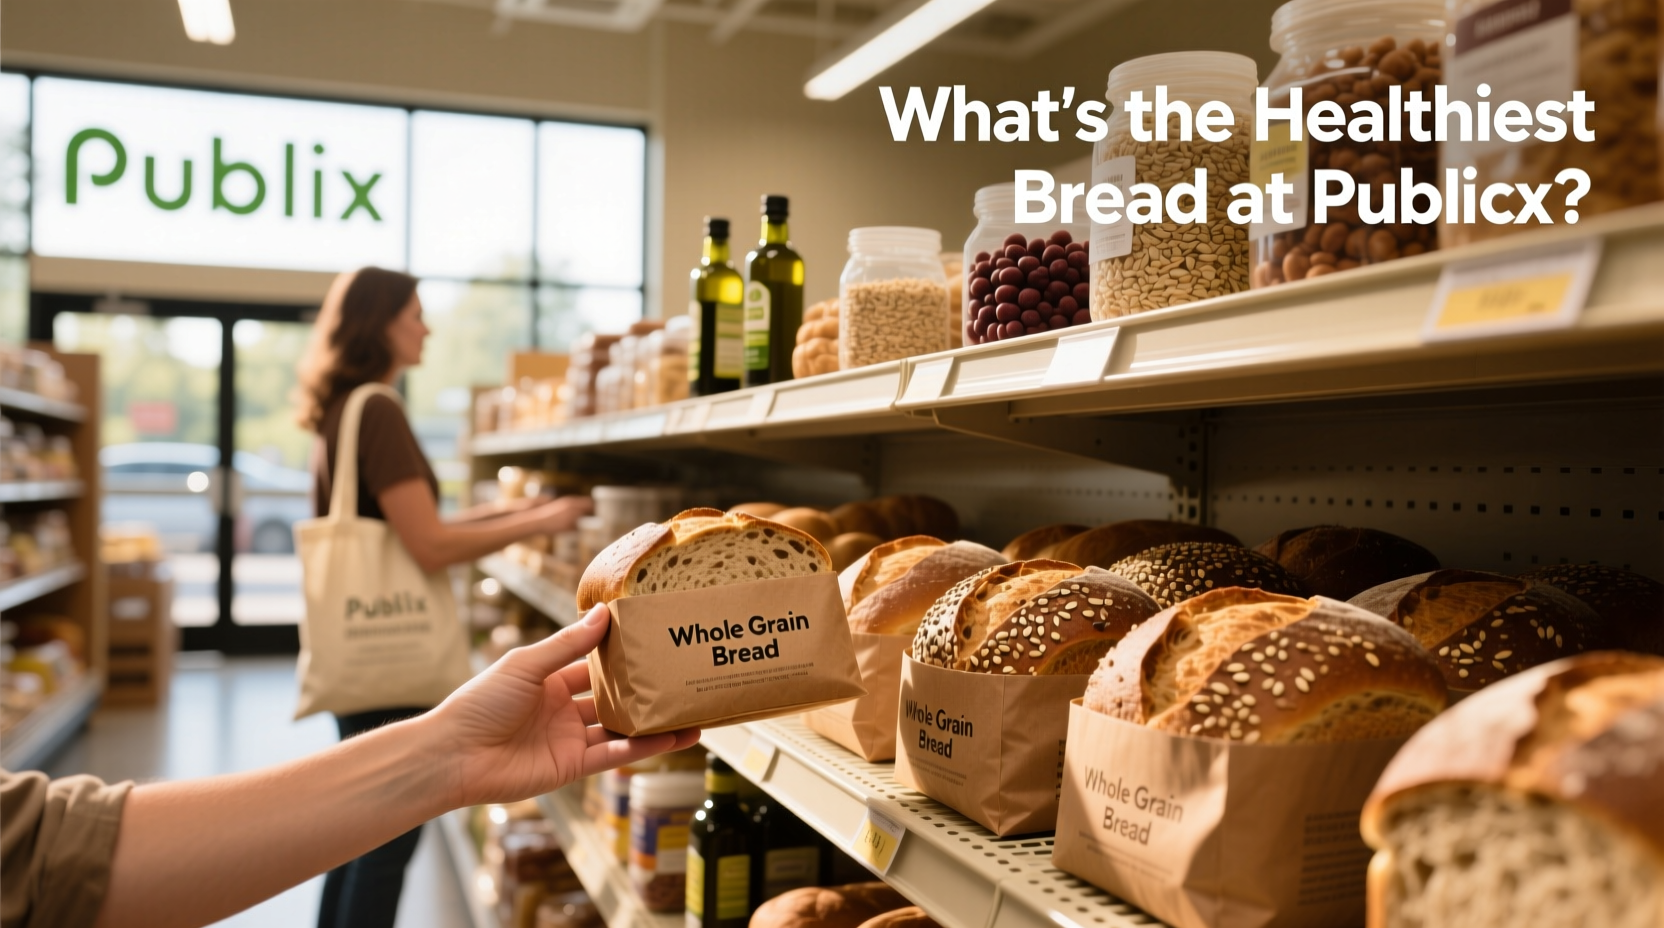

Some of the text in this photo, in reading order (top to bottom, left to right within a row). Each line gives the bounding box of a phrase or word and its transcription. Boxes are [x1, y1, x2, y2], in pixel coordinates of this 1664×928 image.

[65, 128, 383, 221] Publix
[668, 611, 810, 648] Whole Grain
[712, 638, 781, 667] Bread
[936, 709, 973, 738] Grain
[919, 729, 953, 759] Bread
[1084, 765, 1131, 804] Whole
[1134, 786, 1184, 823] Grain
[1103, 805, 1153, 846] Bread
